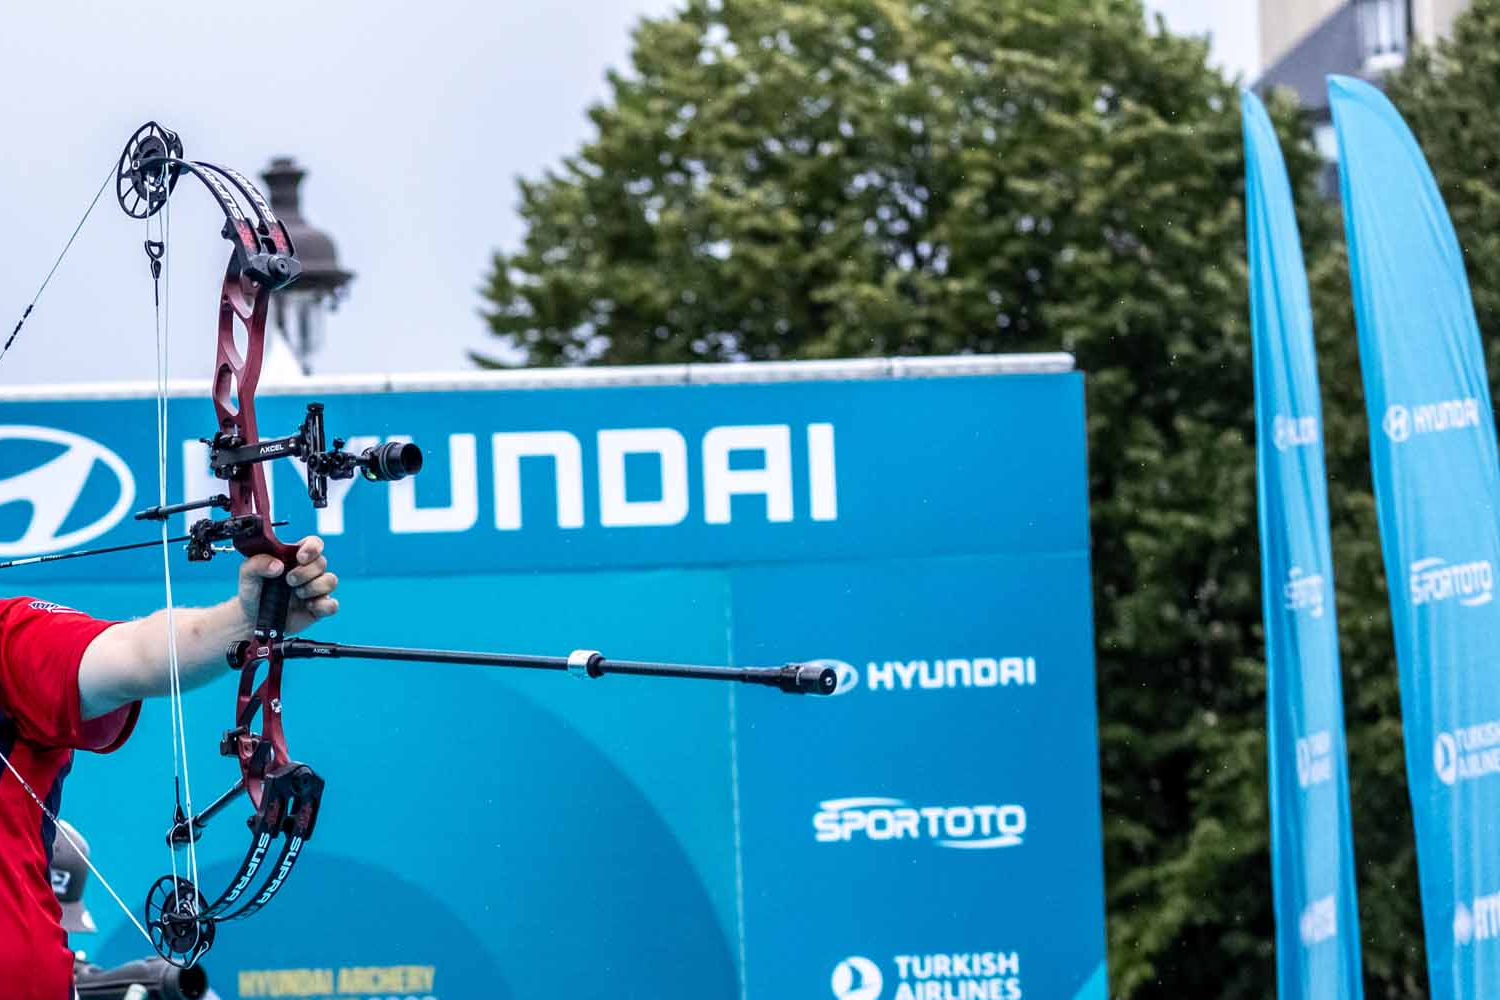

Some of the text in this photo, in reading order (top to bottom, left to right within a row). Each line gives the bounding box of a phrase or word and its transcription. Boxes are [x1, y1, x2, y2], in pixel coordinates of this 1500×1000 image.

[183, 423, 838, 536] HYUNDAI
[867, 657, 1037, 691] HYUNDAI
[812, 803, 1027, 843] SPORTOTO
[239, 966, 436, 998] HYUNDAI ARCHERY
[893, 951, 1020, 980] TURKISH
